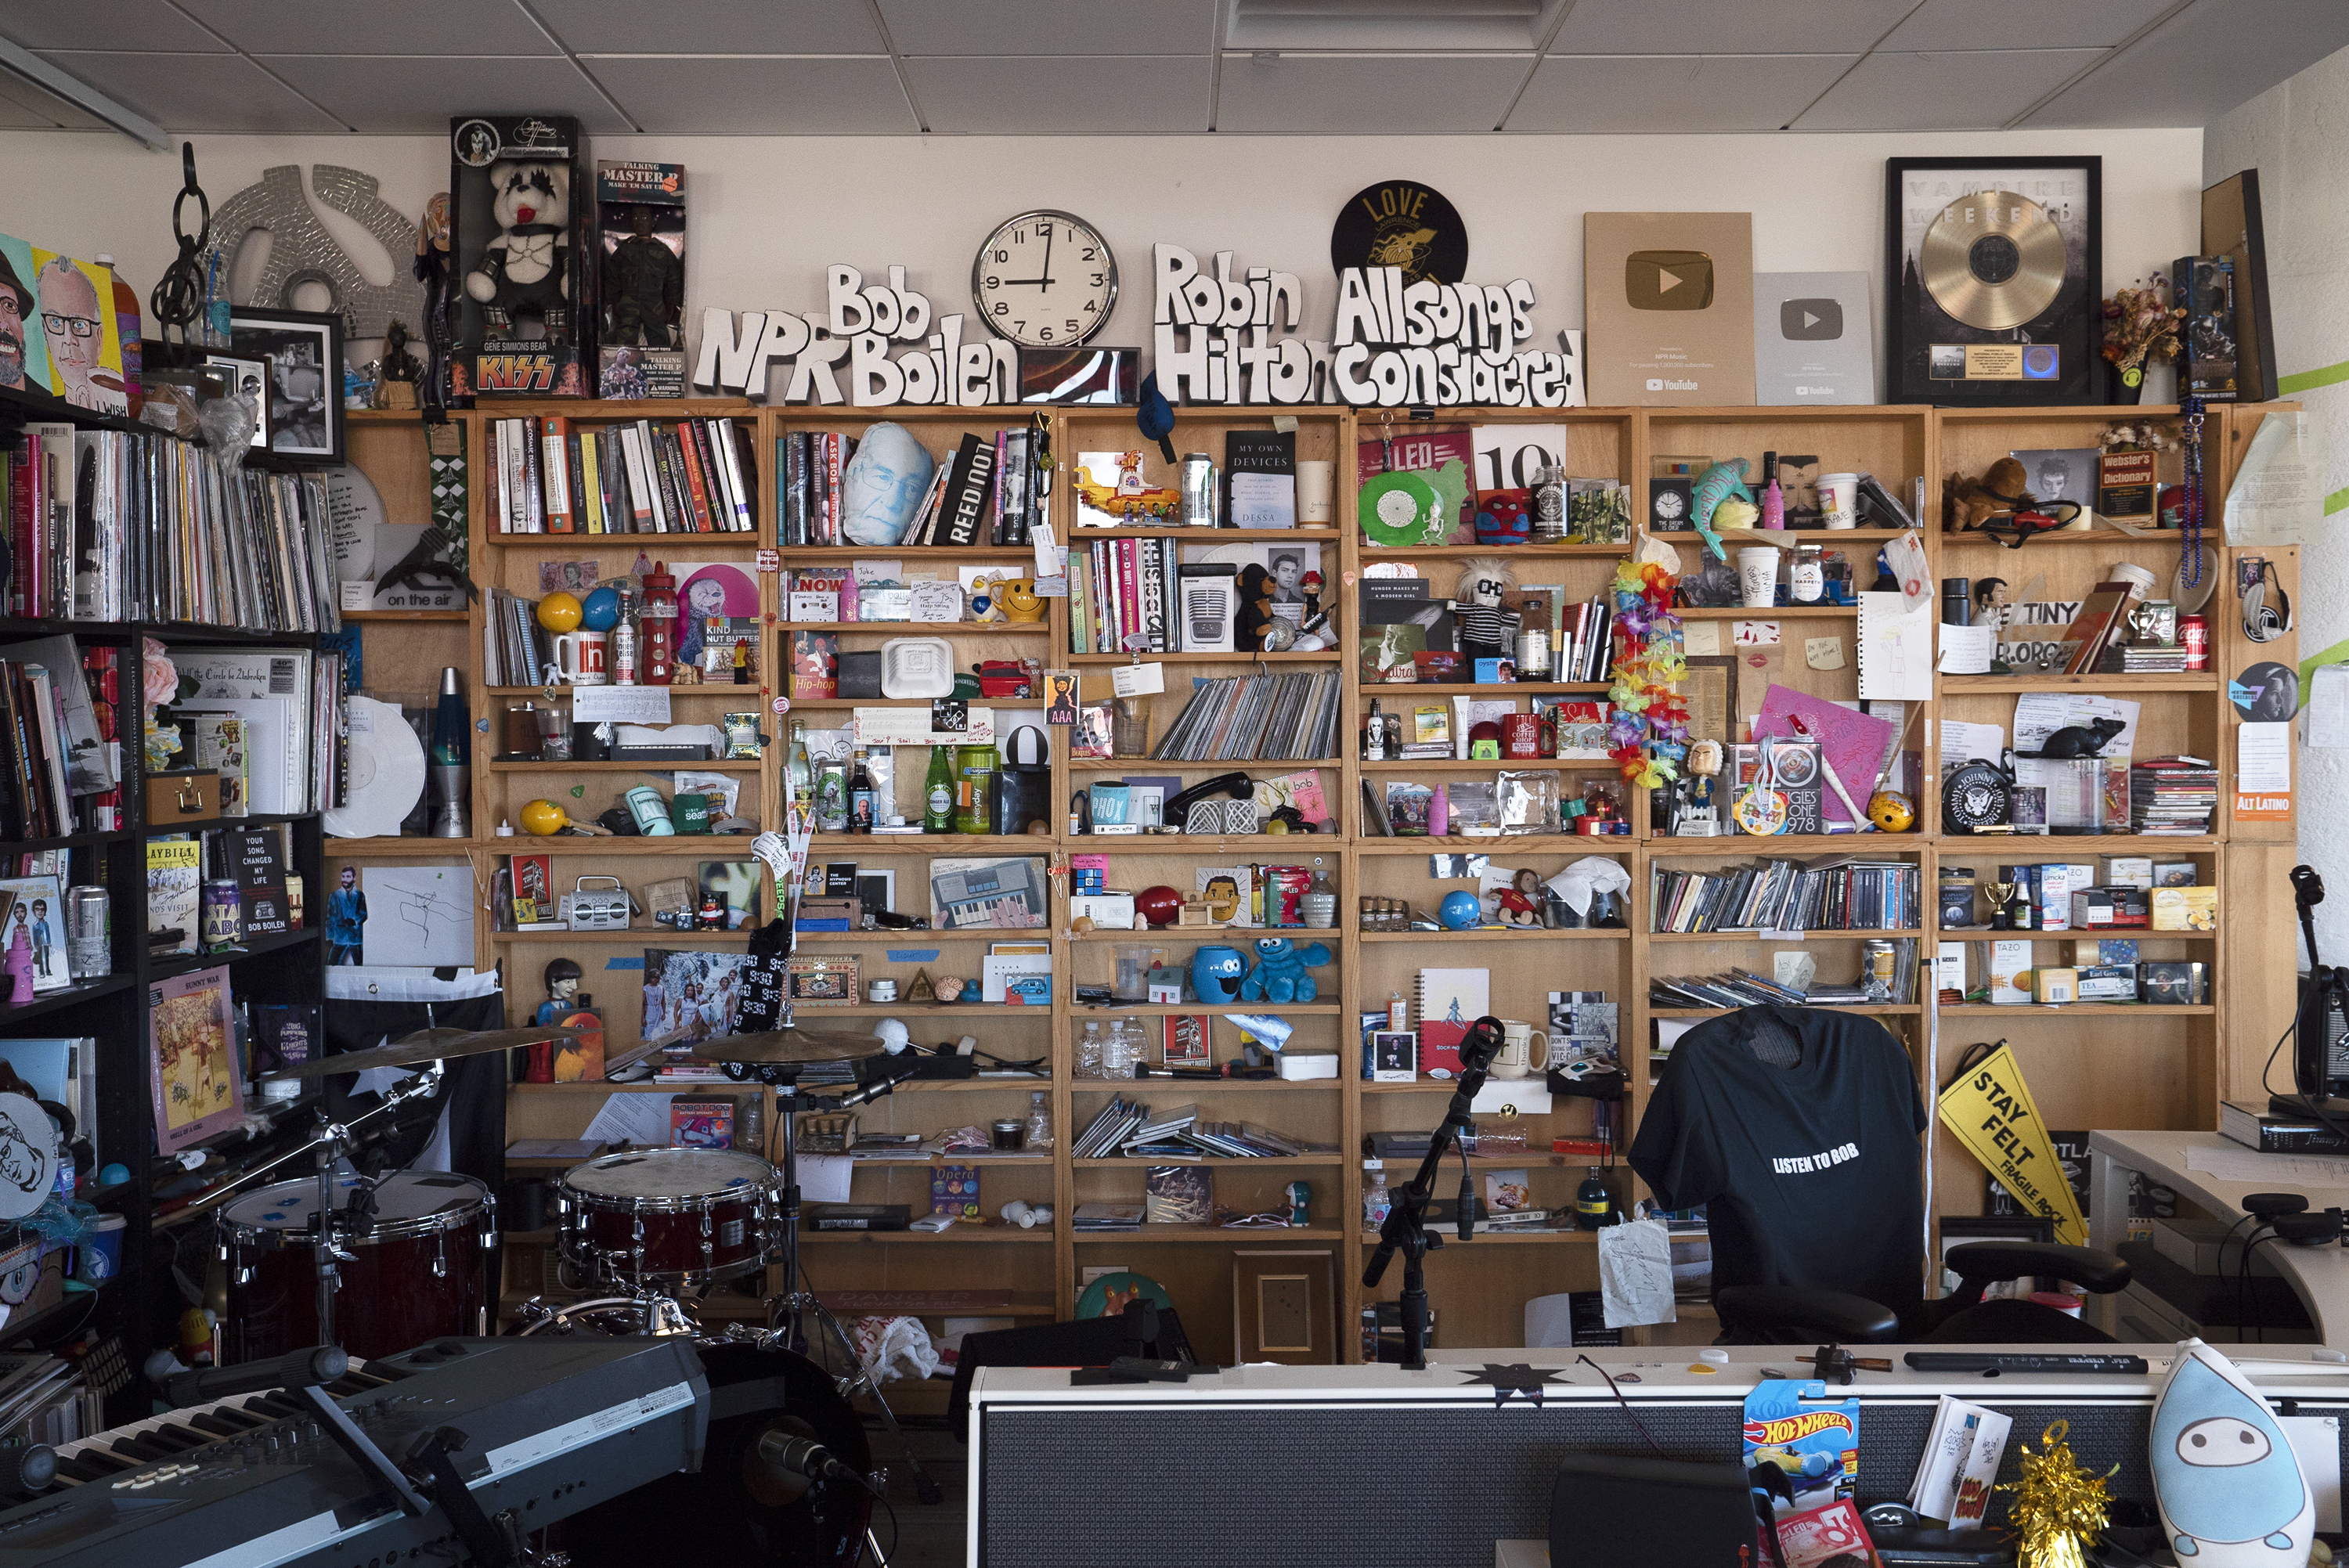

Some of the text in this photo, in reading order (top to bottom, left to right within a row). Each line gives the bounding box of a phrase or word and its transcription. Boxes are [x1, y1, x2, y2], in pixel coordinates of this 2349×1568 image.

[623, 161, 659, 171] TALKING
[604, 168, 664, 183] MASTER
[1362, 188, 1429, 222] LOVE
[1908, 207, 2073, 224] WEEKEND
[1035, 224, 1051, 236] 12
[1376, 217, 1421, 231] LAWRENCE
[1015, 231, 1024, 243] 11
[994, 251, 1009, 263] 10
[1082, 247, 1095, 261] 2
[987, 276, 999, 290] 9
[1090, 274, 1104, 287] 3
[1153, 242, 1303, 332] Robin
[827, 264, 931, 341] Bob
[994, 302, 1009, 315] 8
[1084, 300, 1096, 313] 4
[1334, 267, 1535, 367] Allsongs
[1014, 321, 1026, 334] 7
[1066, 319, 1079, 333] 5
[1040, 327, 1053, 341] 6
[484, 341, 547, 352] GENE SIMMONS BEAR
[694, 306, 1017, 406] NPR Boilen
[1154, 323, 1336, 406] Hilton
[1334, 329, 1587, 408] Considered
[477, 355, 556, 391] KISS
[1665, 379, 1698, 391] YouTube
[96, 401, 127, 416] I WISH
[676, 451, 684, 470] JAGGER
[1234, 457, 1287, 467] DEVICES
[1395, 442, 1438, 470] LED
[2105, 455, 2150, 467] Webster's
[513, 448, 522, 493] jimi hendrix
[528, 457, 536, 482] DANCER
[660, 461, 669, 473] DIY
[969, 443, 994, 484] LOU
[2104, 471, 2152, 484] Dictionary
[951, 488, 984, 544] REED
[858, 567, 875, 576] Joke
[799, 579, 843, 592] NOW
[388, 594, 451, 606] on the air
[2023, 603, 2079, 625] TINY
[205, 667, 266, 684] Circle be Unbroken
[1363, 656, 1416, 681] Sinatra
[796, 679, 835, 692] Hip-hop
[1052, 711, 1072, 723] AAA
[1071, 748, 1092, 757] BEATLES
[1292, 778, 1313, 791] bob
[1961, 773, 1997, 788] JOHNNY
[971, 788, 980, 824] everyday
[1788, 805, 1817, 817] ONE
[1951, 788, 2004, 824] TOMMY JOEY
[2237, 797, 2289, 811] ALT.LATINO
[246, 836, 263, 845] YOUR
[1048, 866, 1071, 876] DANCE
[172, 903, 189, 913] VISIT
[247, 921, 285, 932] BOB BOILEN
[185, 975, 220, 990] SUNNY WAR
[1975, 1072, 2028, 1124] STAY
[1981, 1114, 2036, 1164] FELT
[2305, 1134, 2341, 1147] Jimmy
[1773, 1141, 1860, 1174] LISTEN TO BOB
[936, 1170, 974, 1183] Opera
[2000, 1160, 2067, 1229] FRAGILE ROCK
[838, 1292, 971, 1300] DANGER
